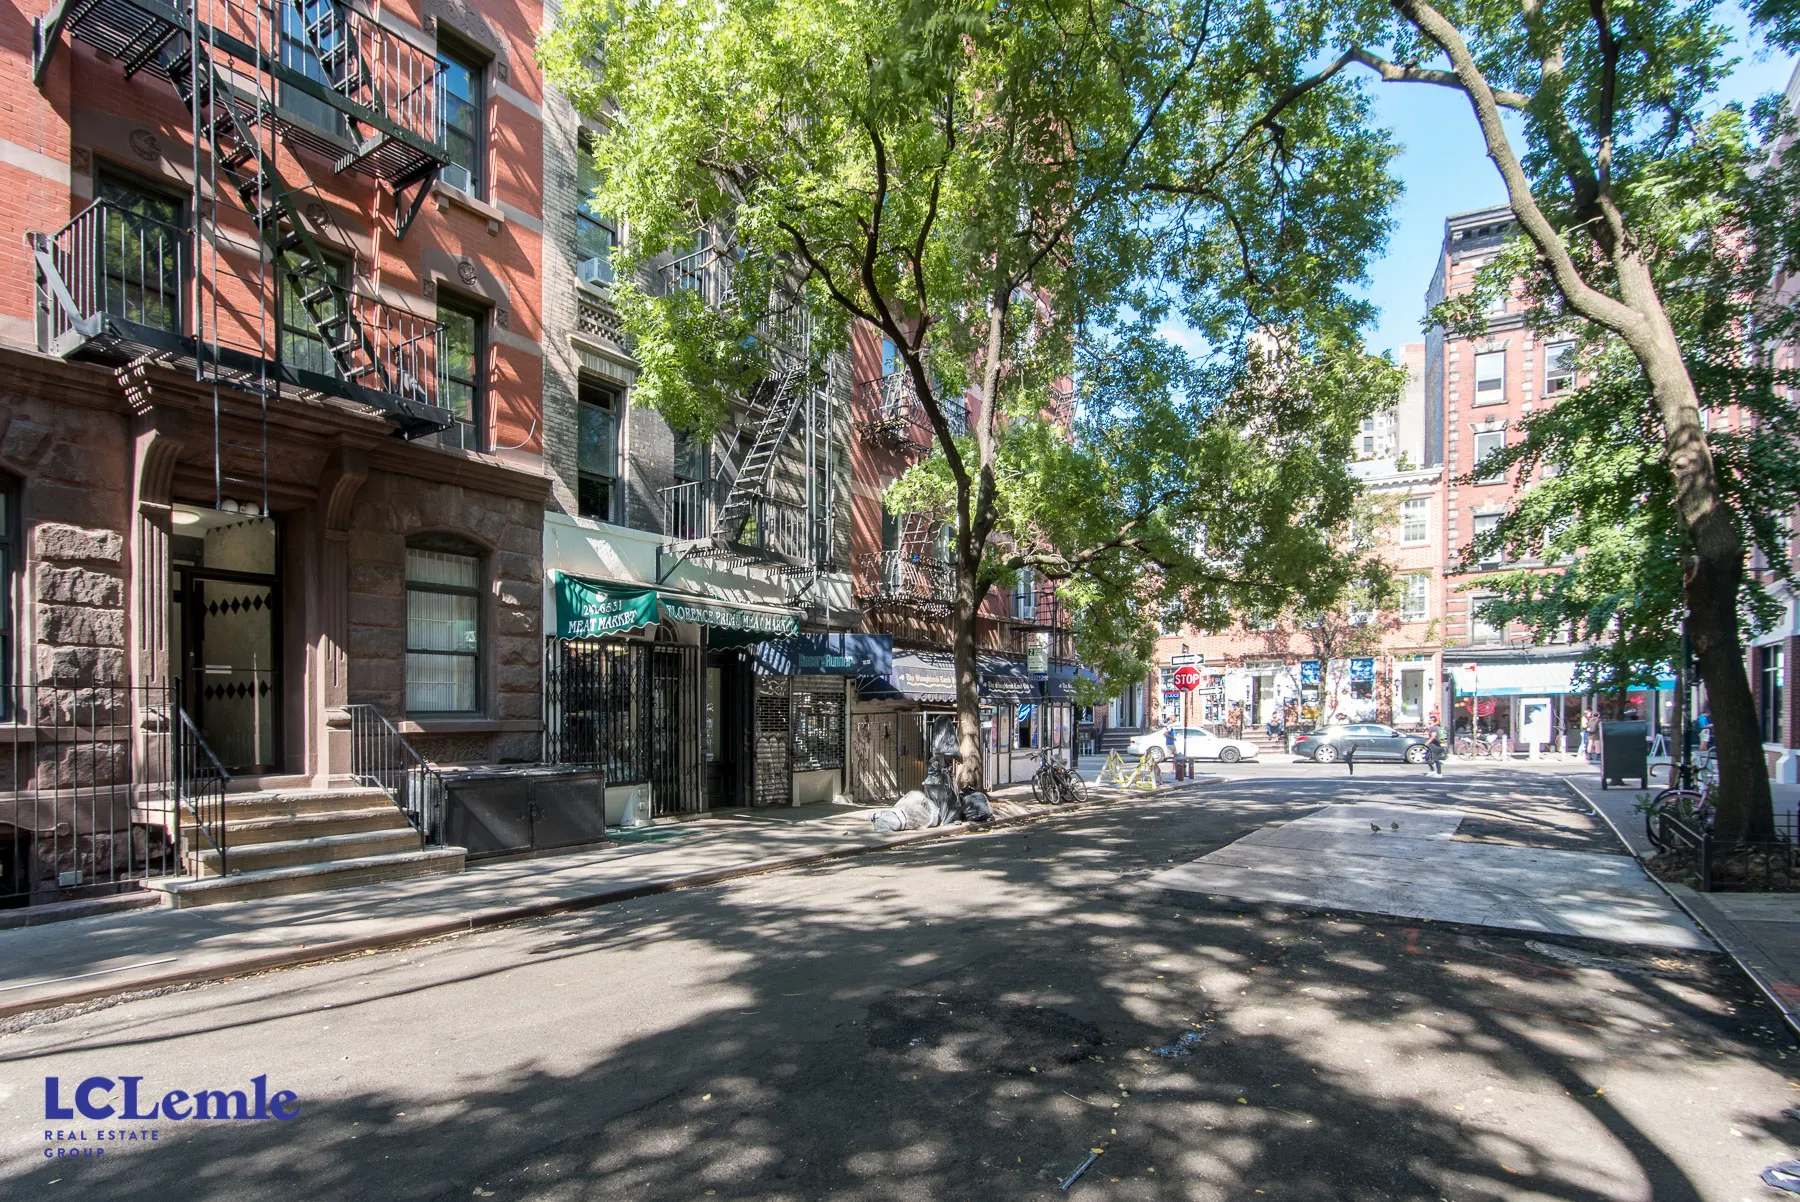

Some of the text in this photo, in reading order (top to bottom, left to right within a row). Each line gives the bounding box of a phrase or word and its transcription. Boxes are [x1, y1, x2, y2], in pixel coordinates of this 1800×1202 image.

[567, 609, 637, 634] MEAT MARKET
[666, 604, 714, 623] FLORENCE
[1174, 673, 1200, 685] STOP
